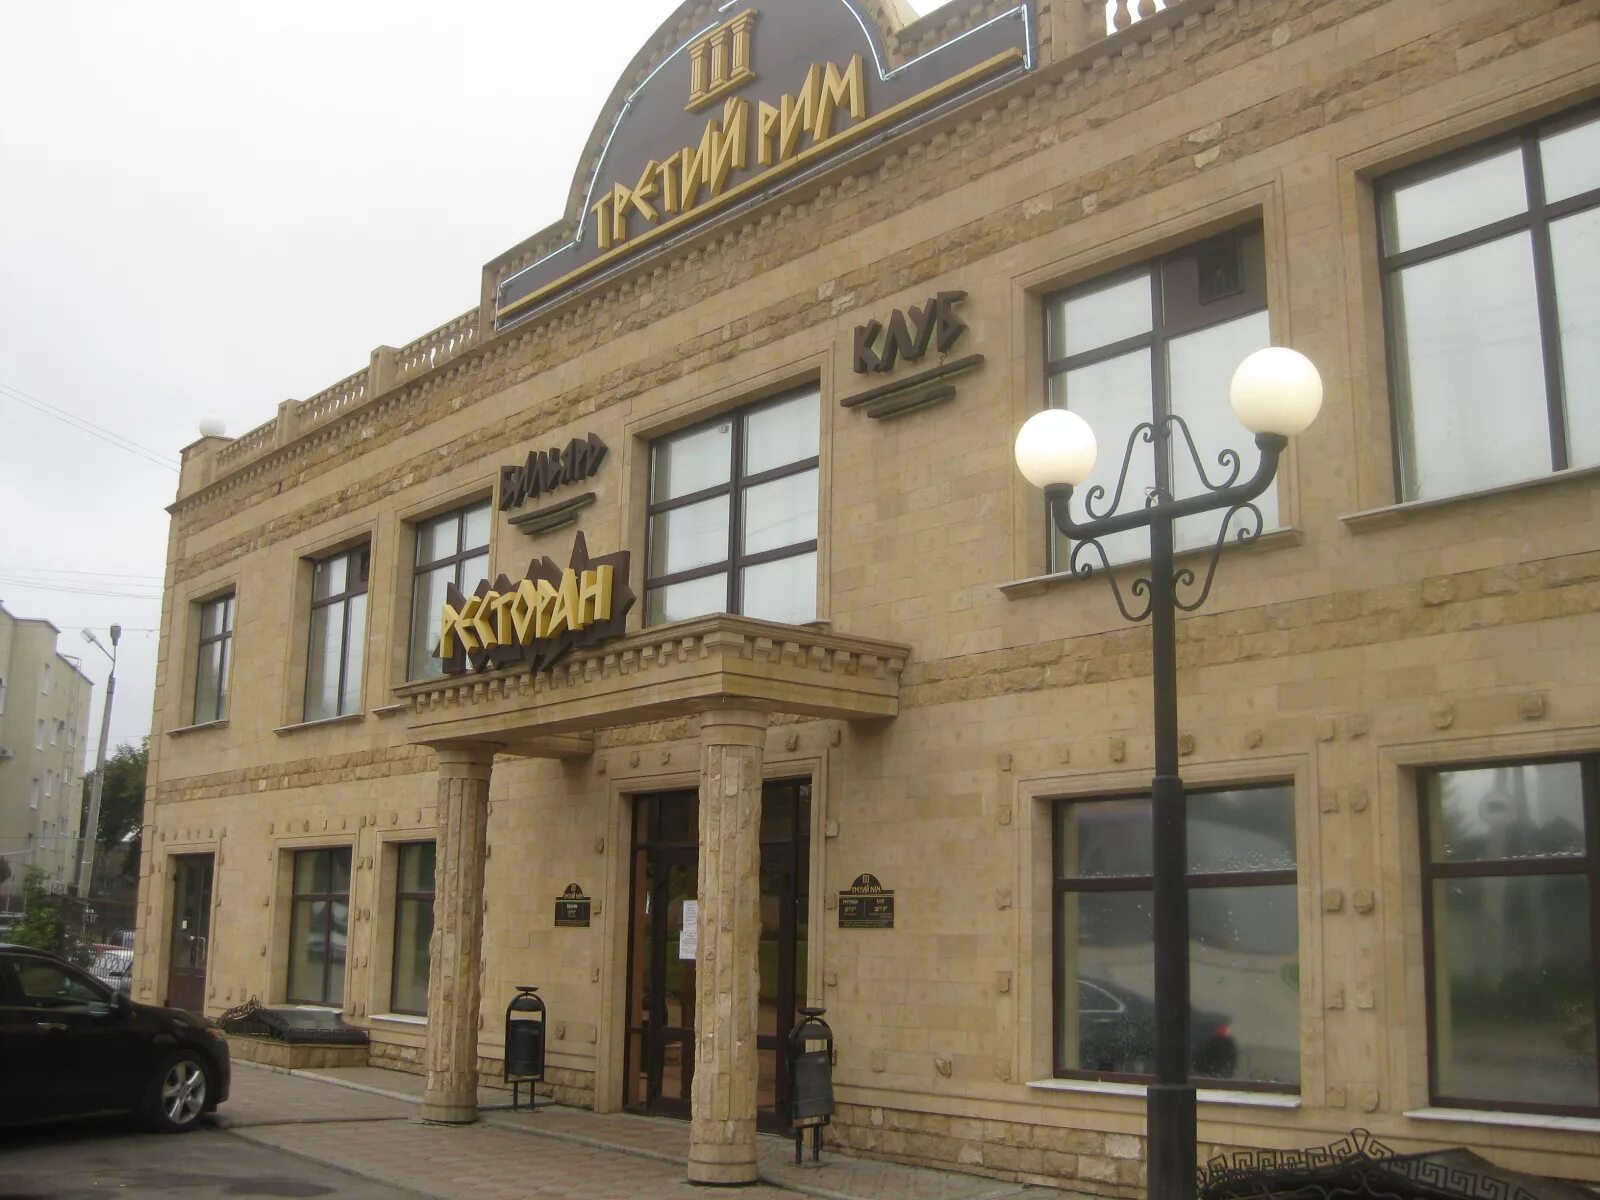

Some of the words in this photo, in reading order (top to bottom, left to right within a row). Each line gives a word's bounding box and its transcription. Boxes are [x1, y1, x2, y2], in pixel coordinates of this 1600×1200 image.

[591, 96, 748, 250] ТРЕТИЙ
[757, 52, 865, 166] РИМ
[853, 290, 968, 374] КЛУБ
[439, 564, 614, 658] РЕСТОРАН
